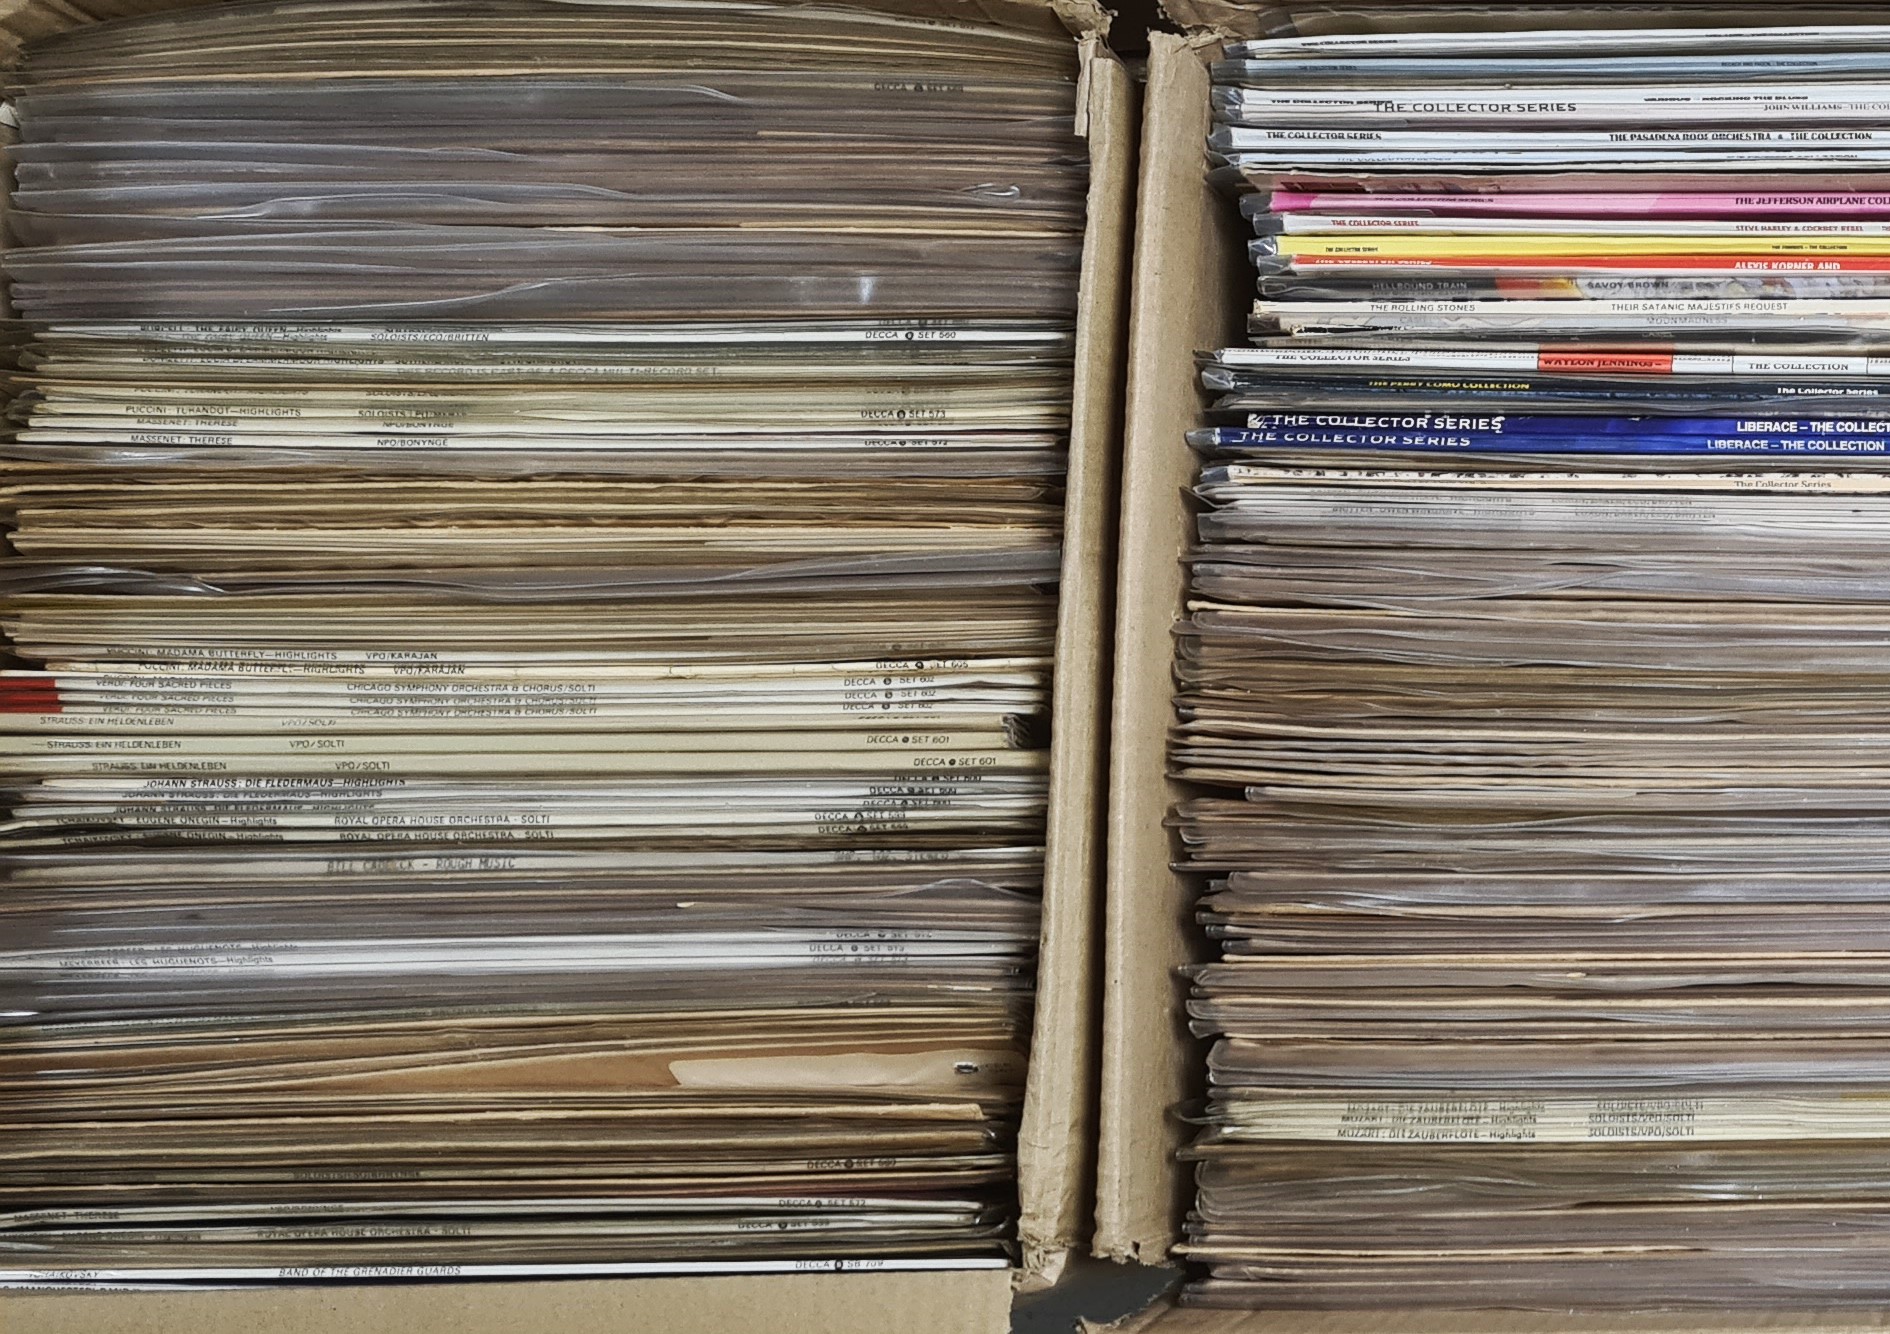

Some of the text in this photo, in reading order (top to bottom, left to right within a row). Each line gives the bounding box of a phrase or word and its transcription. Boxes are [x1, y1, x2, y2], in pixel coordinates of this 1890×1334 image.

[1413, 103, 1512, 112] COLLECTOR
[1517, 103, 1577, 112] SERIES
[1816, 197, 1866, 205] AIRPLANE
[1642, 303, 1684, 311] SATANIC
[1273, 415, 1502, 429] THE COLLECTOR SERIES
[1737, 422, 1798, 433] LIBERACE
[1809, 422, 1833, 433] THE
[1240, 431, 1277, 441] THE
[1284, 433, 1397, 444] COLLECTOR
[1707, 440, 1885, 450] LIBERACE THE COLLECTION
[867, 735, 950, 744] DECCA SET 601
[913, 757, 997, 766] DECCA SET 601
